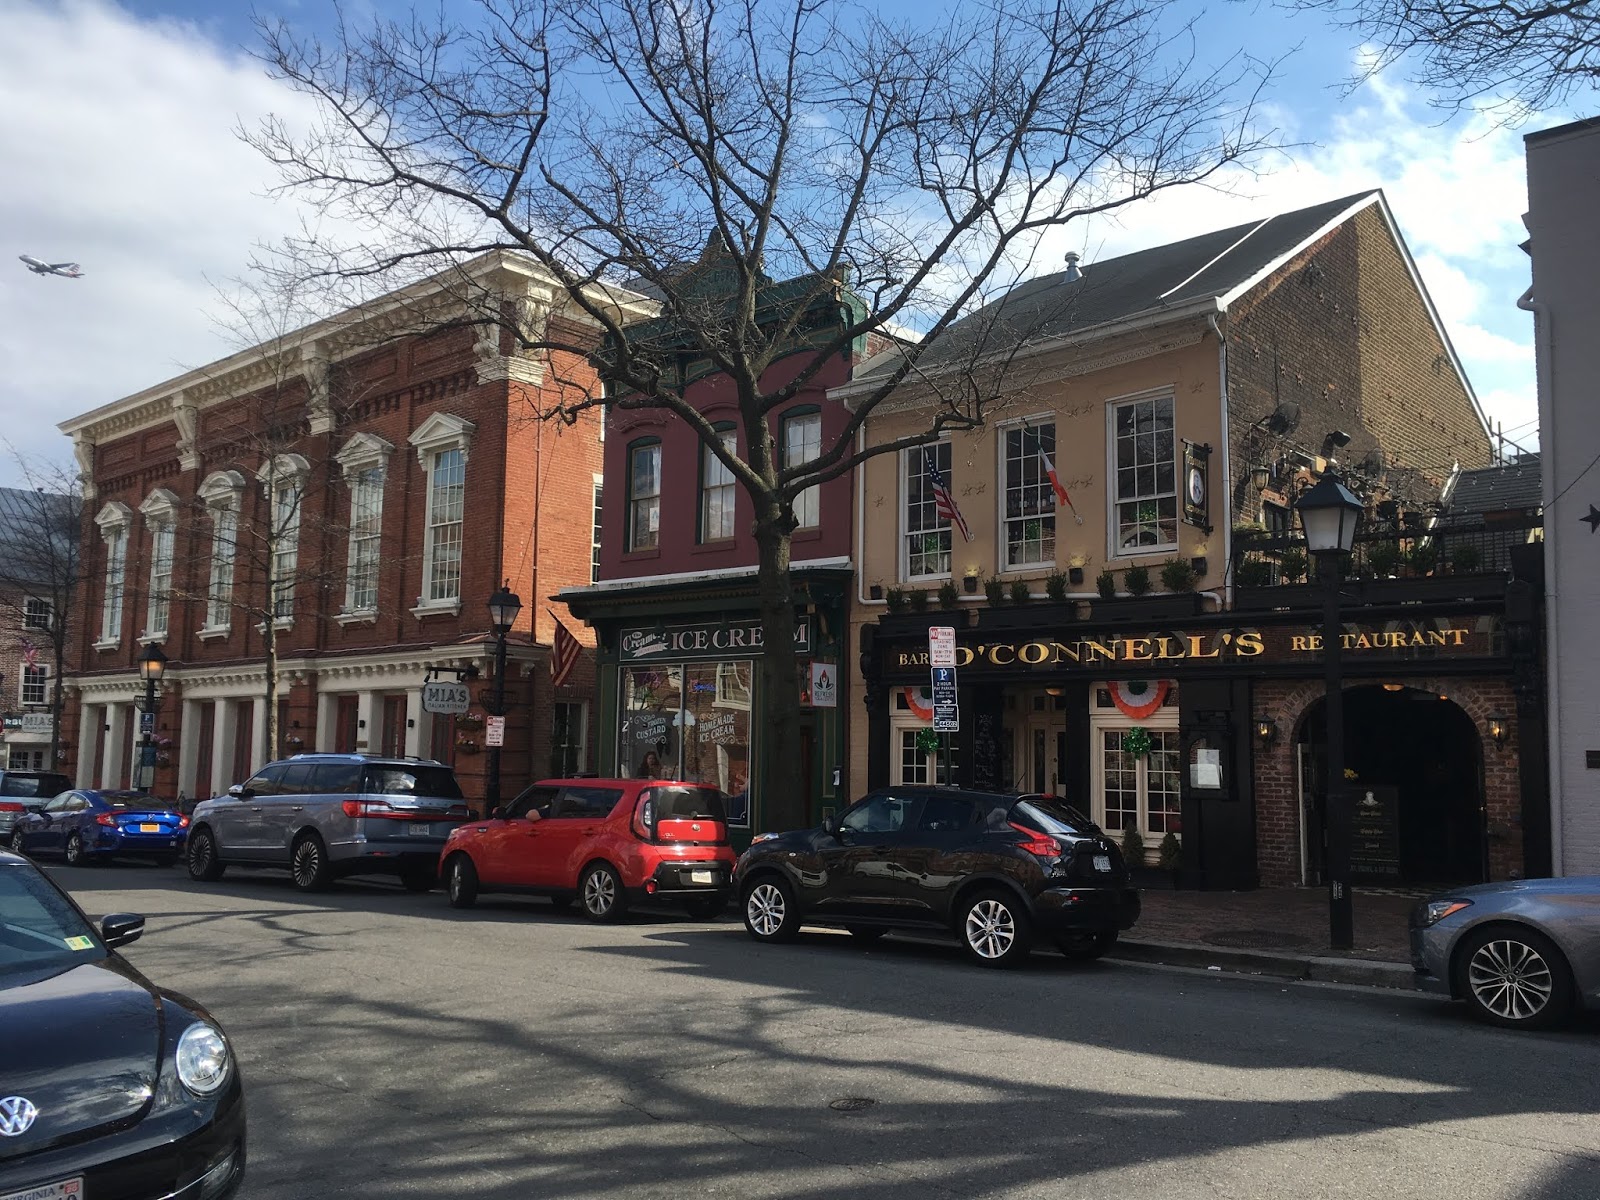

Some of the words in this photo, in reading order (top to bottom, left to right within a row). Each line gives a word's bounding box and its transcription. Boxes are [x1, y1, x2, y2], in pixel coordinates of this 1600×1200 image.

[671, 629, 708, 650] ICE
[713, 623, 807, 649] CREM
[930, 629, 938, 638] NO
[899, 653, 929, 666] BAR
[1291, 629, 1469, 651] RETAURANT
[940, 668, 948, 680] P
[428, 688, 467, 702] MIA'S
[648, 717, 666, 728] FROZEN
[700, 714, 735, 732] HOMEMADE
[636, 725, 666, 739] CUSTARD
[700, 732, 710, 742] ICE
[710, 725, 735, 738] CREAM
